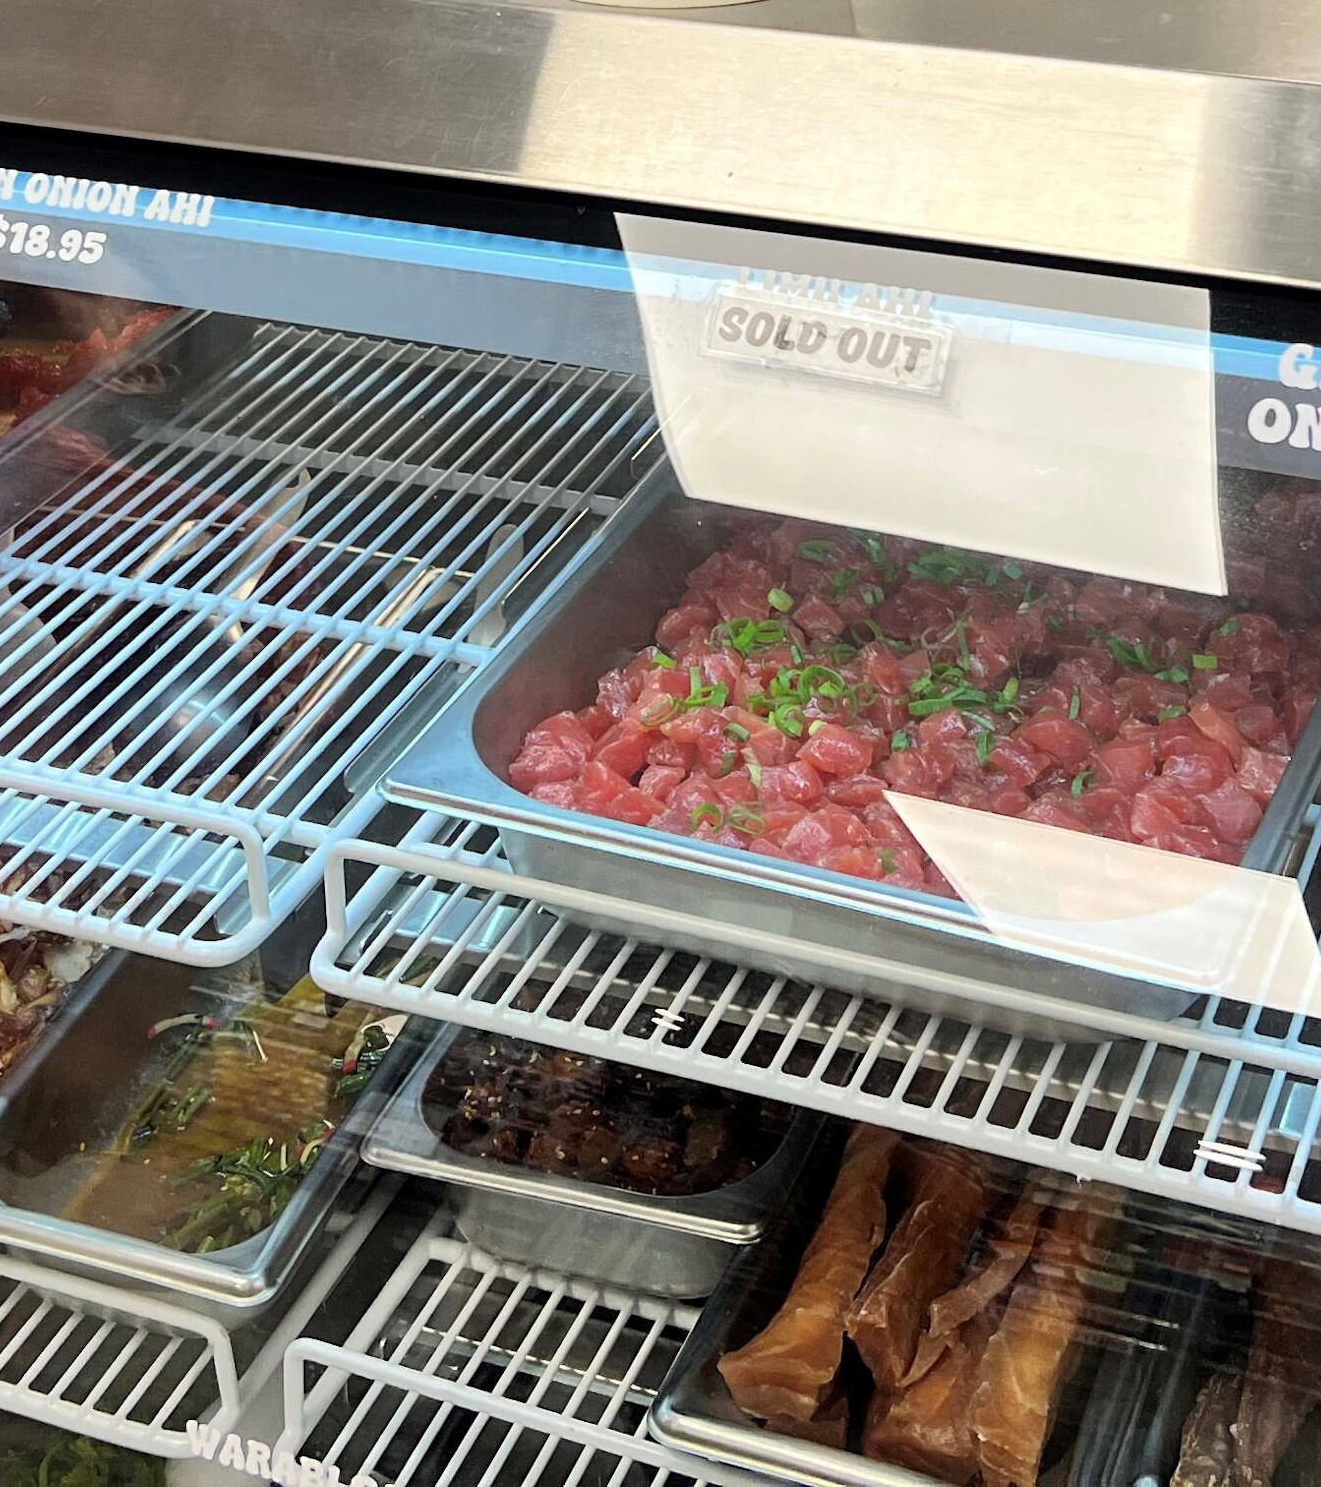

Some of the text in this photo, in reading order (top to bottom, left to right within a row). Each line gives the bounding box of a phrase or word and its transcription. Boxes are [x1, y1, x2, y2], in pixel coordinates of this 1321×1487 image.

[24, 172, 140, 218] ONION
[144, 189, 215, 228] AHI
[718, 306, 932, 373] SOLD OUT
